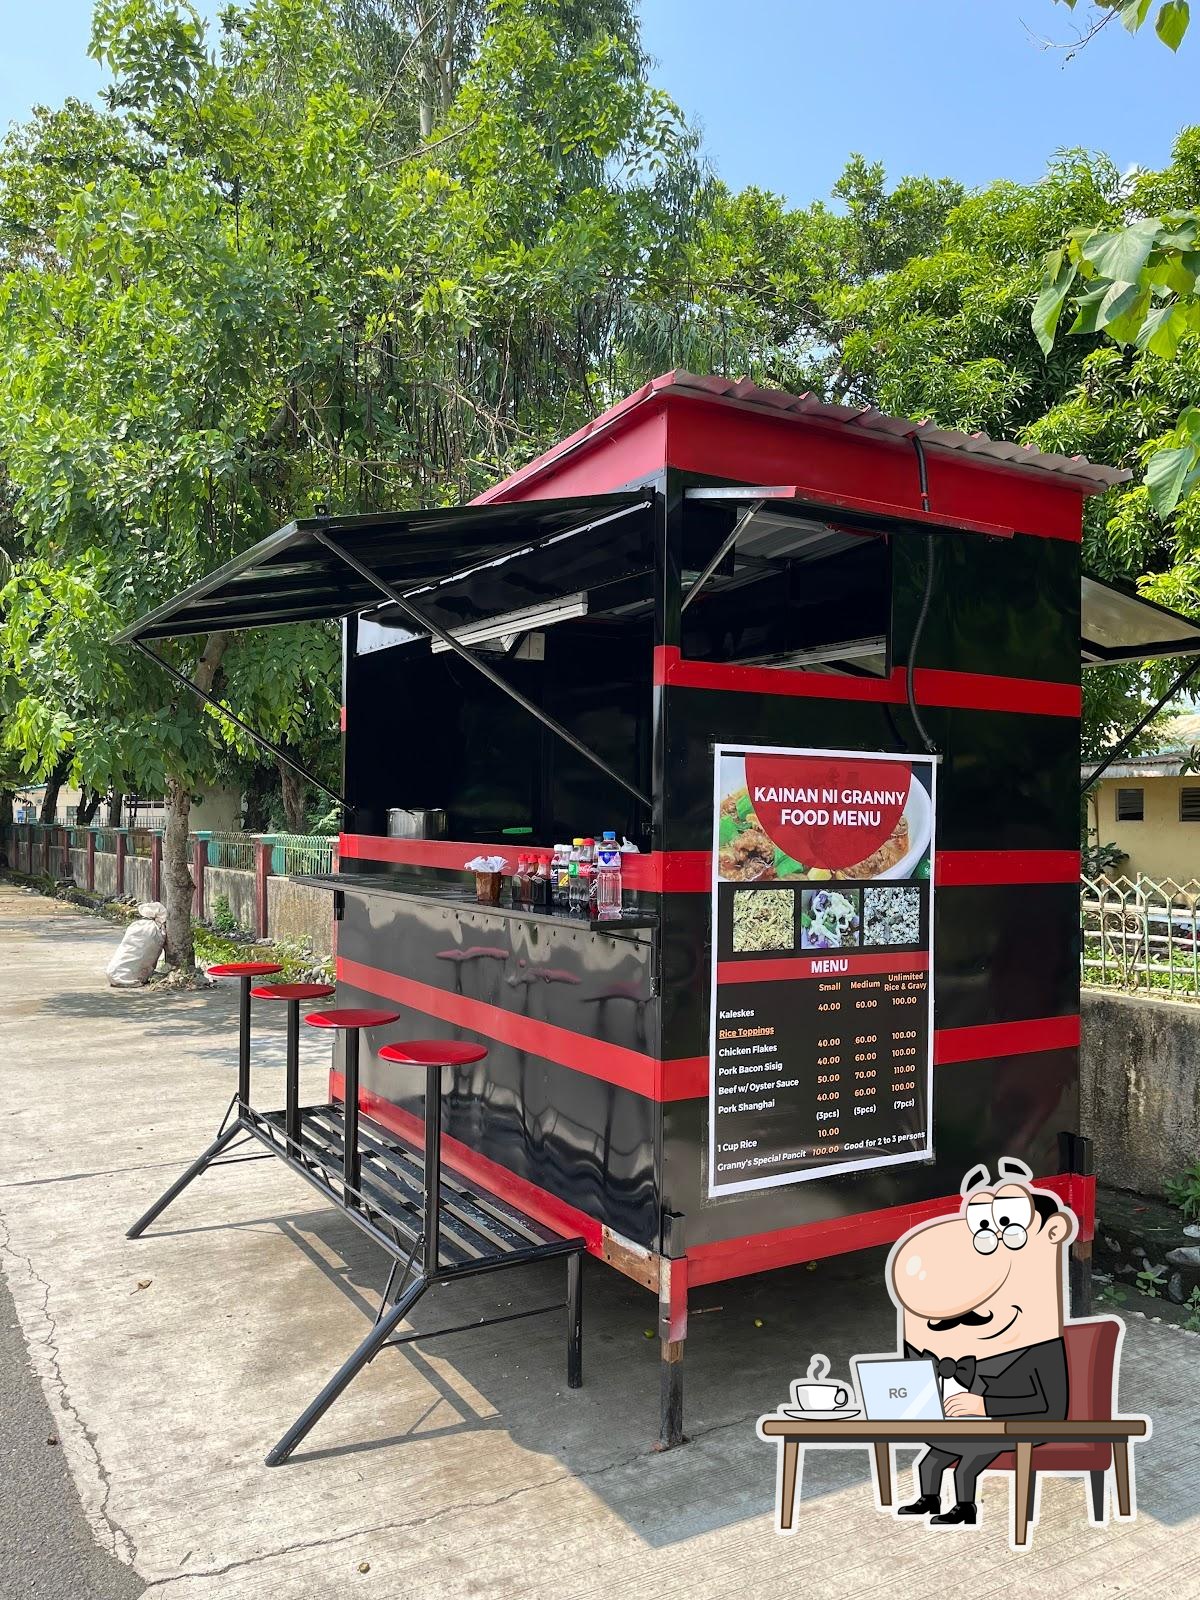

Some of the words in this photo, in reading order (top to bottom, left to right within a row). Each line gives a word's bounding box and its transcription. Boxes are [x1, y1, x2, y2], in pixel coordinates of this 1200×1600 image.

[754, 787, 819, 803] KAINAN
[822, 790, 838, 803] NI
[841, 790, 905, 805] GRANNY
[781, 810, 829, 825] FOOD
[833, 811, 881, 826] MENU
[811, 960, 848, 973] MENU
[888, 973, 923, 981] Unlimited
[819, 983, 841, 992] Small
[850, 980, 880, 990] Medium
[884, 983, 899, 992] Rice
[908, 982, 927, 992] Gravy
[818, 1002, 841, 1011] 40.00
[856, 1000, 877, 1009] 60.00
[892, 997, 917, 1005] 100.00
[720, 1009, 755, 1019] Kaleskes
[719, 1029, 736, 1039] Rice
[738, 1026, 774, 1037] Toppings
[818, 1038, 840, 1047] 40.00
[855, 1035, 877, 1044] 60.00
[892, 1031, 916, 1040] 100.00
[719, 1046, 751, 1057] Chicken
[753, 1044, 777, 1054] Flakes
[817, 1056, 840, 1065] 40.00
[855, 1052, 877, 1061] 60.00
[892, 1048, 916, 1057] 100.00
[719, 1066, 737, 1076] Pork
[739, 1063, 763, 1073] Bacon
[765, 1062, 783, 1072] Sisig
[817, 1074, 840, 1083] 50.00
[855, 1069, 876, 1079] 70.00
[893, 1065, 915, 1074] 110.00
[718, 1085, 737, 1095] Beef
[738, 1082, 749, 1093] w/
[750, 1081, 775, 1092] Oyster
[777, 1078, 799, 1088] Sauce
[817, 1092, 840, 1101] 40.00
[855, 1087, 876, 1096] 60.00
[892, 1082, 915, 1092] 100.00
[718, 1104, 737, 1114] Pork
[739, 1099, 775, 1112] Shanghai
[816, 1109, 840, 1120] (3pcs)
[854, 1105, 876, 1116] (5pcs)
[894, 1099, 915, 1109] (7pcs)
[818, 1128, 839, 1137] 10.00
[718, 1144, 721, 1152] 1
[723, 1142, 739, 1153] Cup
[740, 1140, 757, 1149] Rice
[812, 1145, 839, 1156] 100.00
[844, 1141, 864, 1151] Good
[866, 1139, 876, 1147] for
[898, 1131, 925, 1143] persons
[718, 1159, 752, 1172] Granny's
[753, 1155, 781, 1166] Special
[783, 1150, 806, 1160] Pancit
